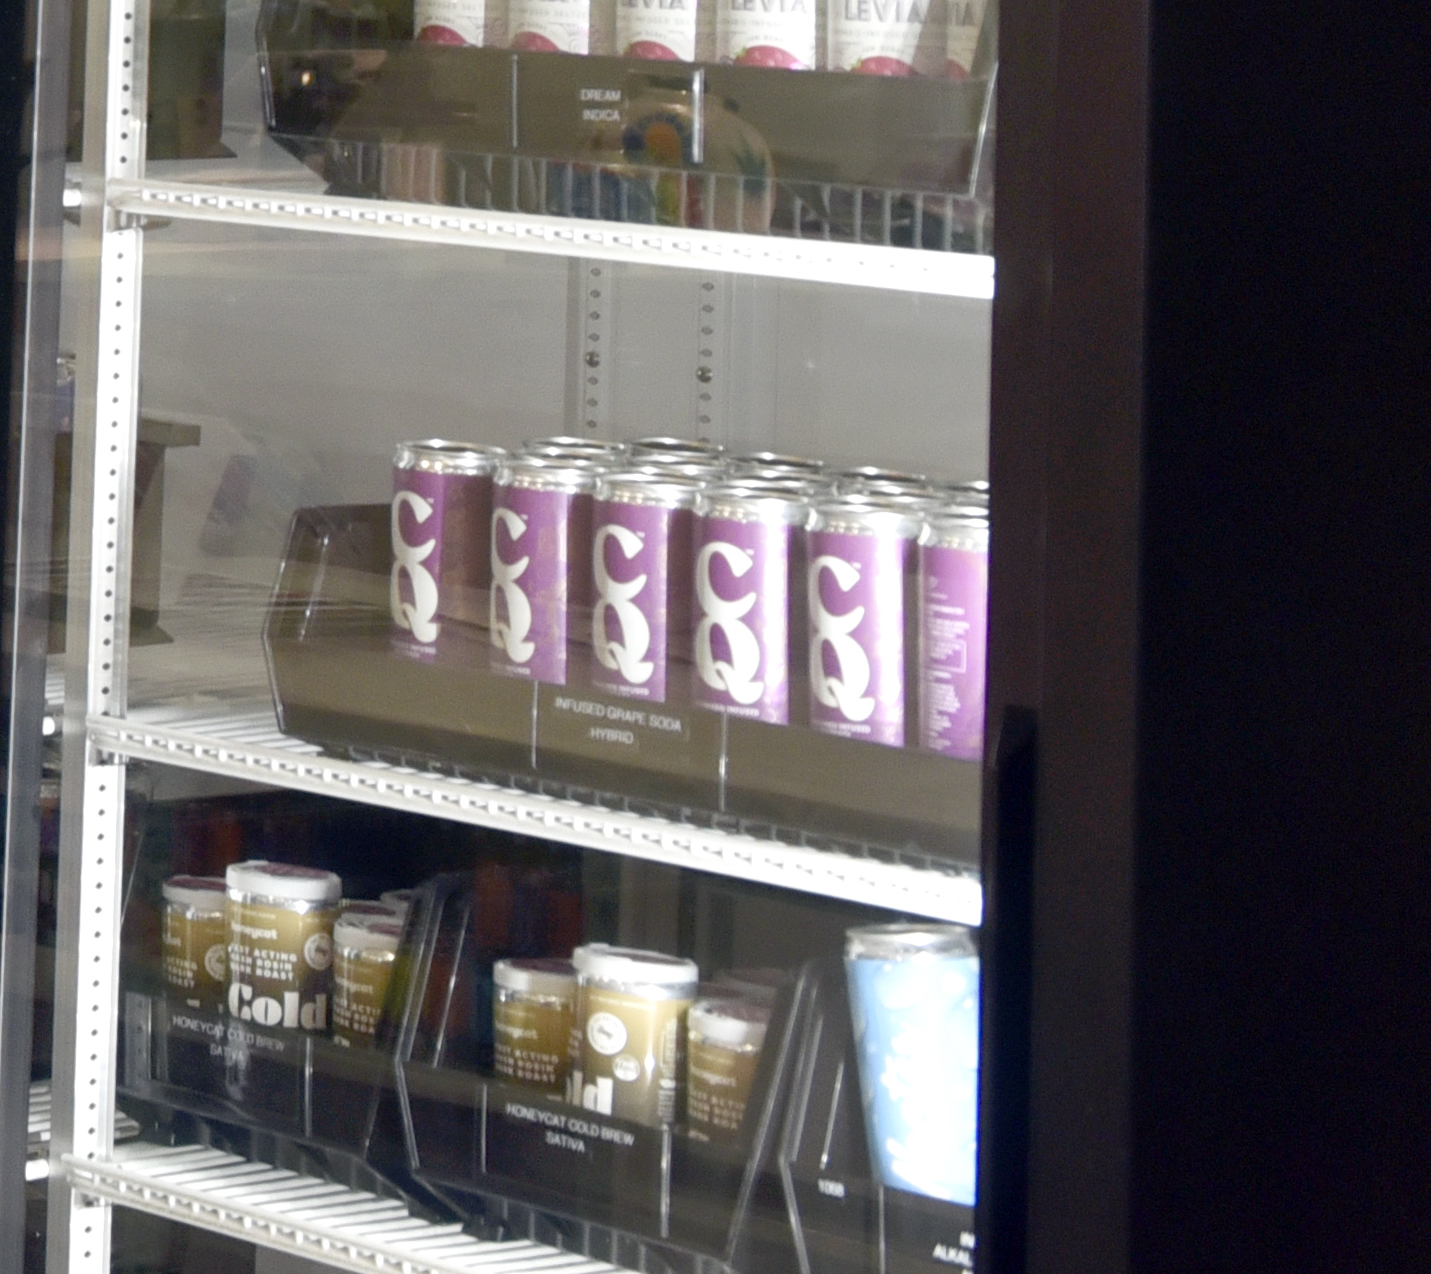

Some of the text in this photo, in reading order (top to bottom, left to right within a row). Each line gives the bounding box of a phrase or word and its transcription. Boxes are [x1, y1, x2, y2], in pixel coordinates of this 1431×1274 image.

[581, 89, 621, 103] DREAM
[583, 109, 620, 122] INDICA
[556, 697, 682, 733] INFUSED GRAPE SODA
[591, 727, 634, 744] HYBRID
[229, 983, 327, 1029] Cold
[506, 1103, 634, 1146] HONEYCAT COLD BREW
[546, 1132, 585, 1153] SATIVA
